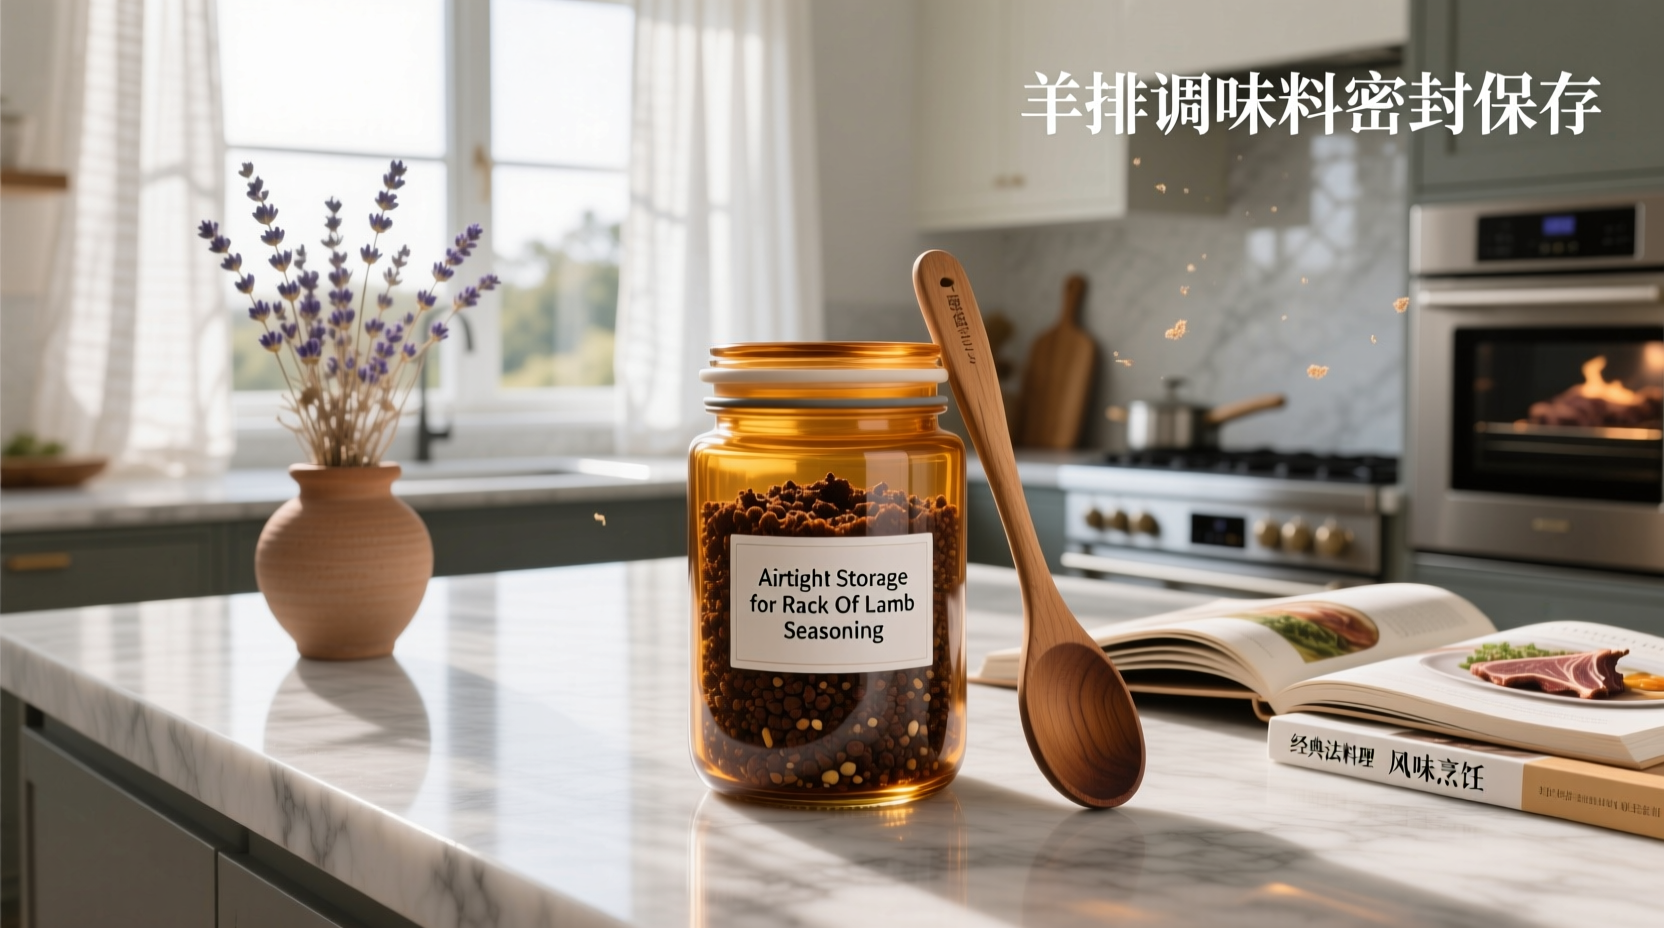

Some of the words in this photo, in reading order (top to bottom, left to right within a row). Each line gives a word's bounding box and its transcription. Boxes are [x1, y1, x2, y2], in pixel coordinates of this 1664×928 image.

[758, 568, 830, 592] Airtight
[836, 569, 908, 591] Storage
[750, 593, 777, 613] for
[782, 595, 829, 614] Rack
[835, 595, 860, 614] Of
[865, 593, 915, 614] Lamb
[784, 621, 884, 643] Seasoning
